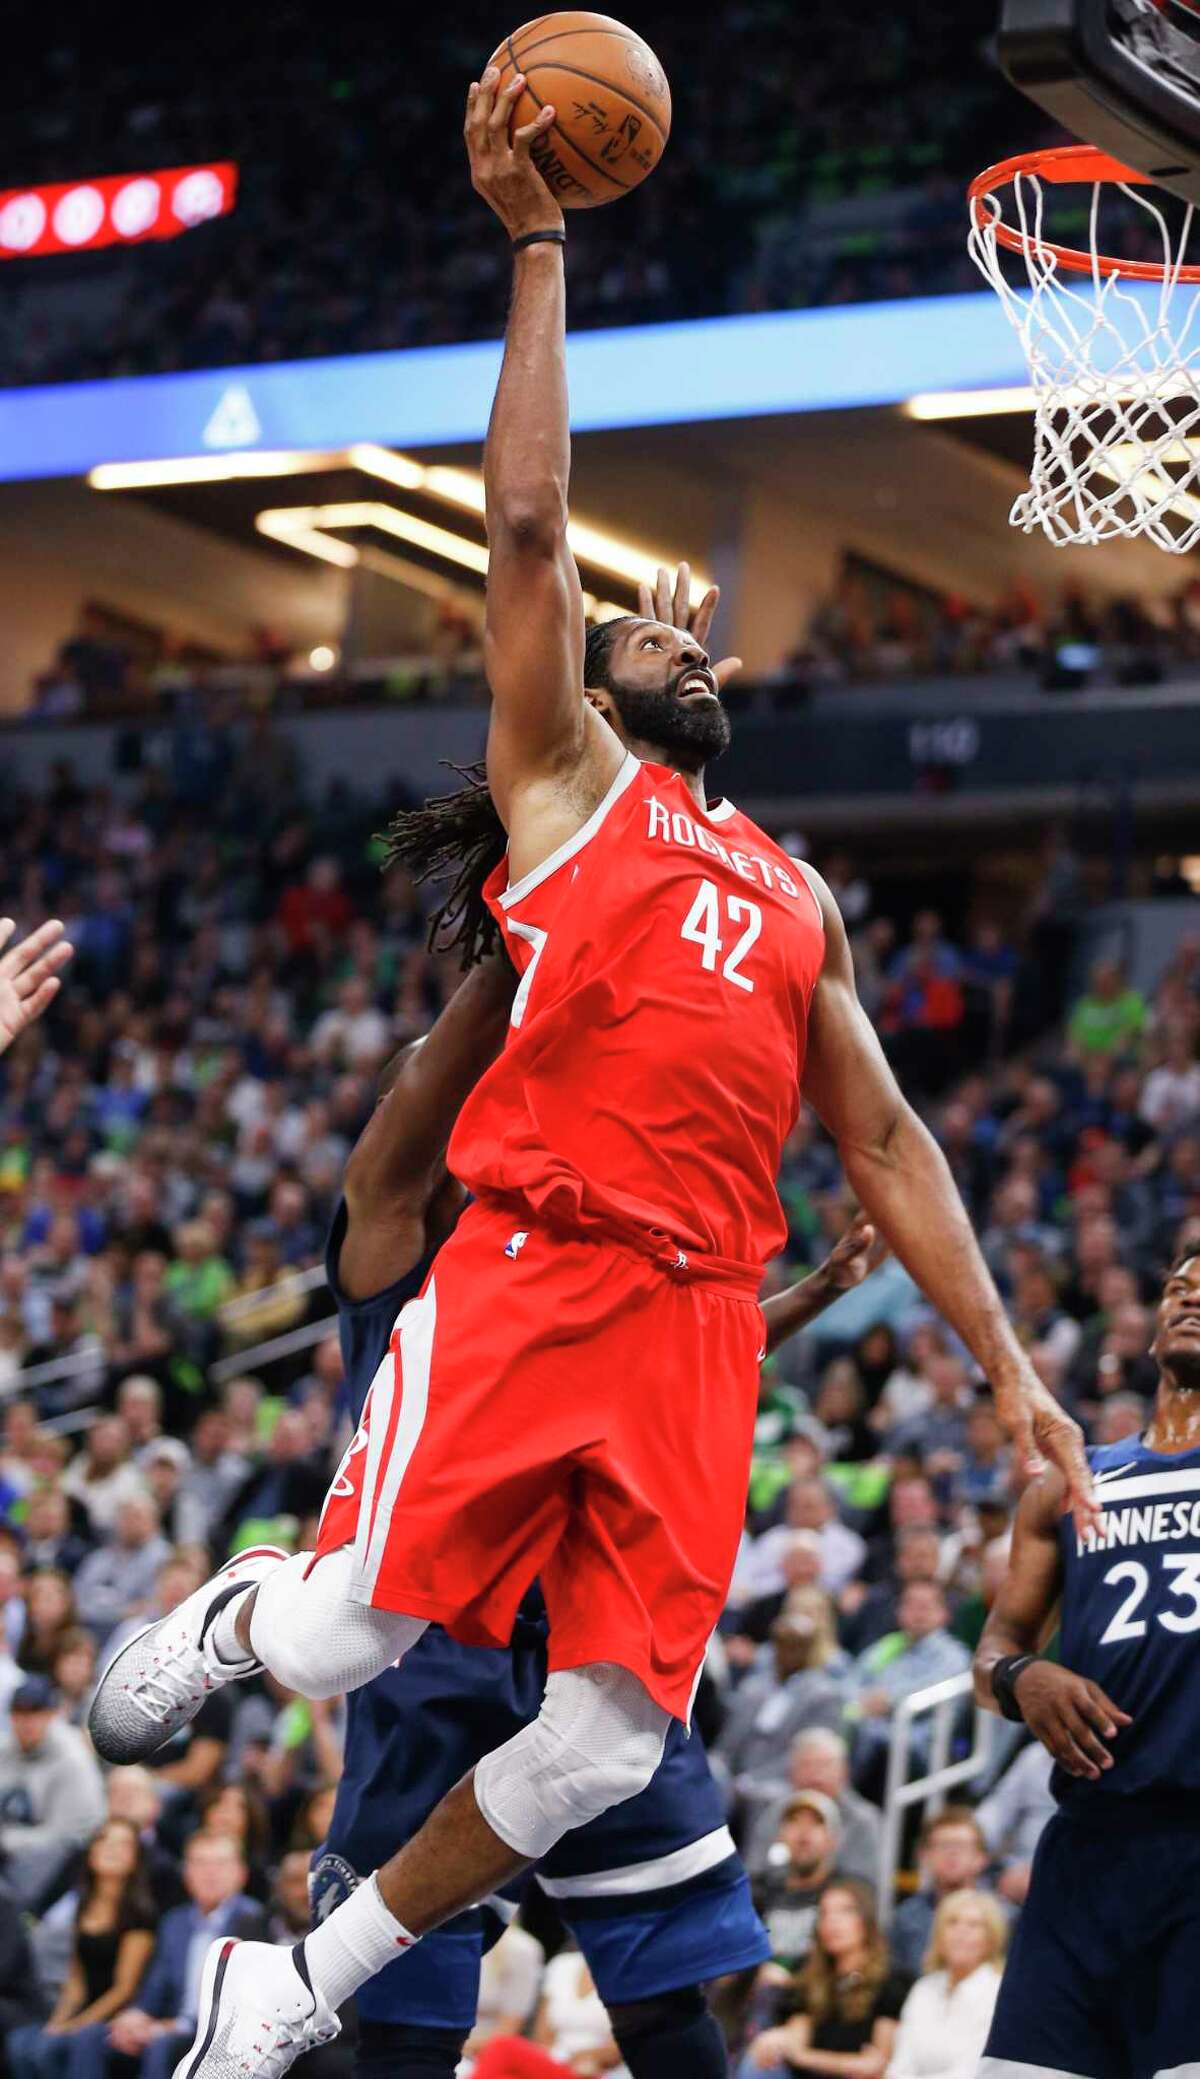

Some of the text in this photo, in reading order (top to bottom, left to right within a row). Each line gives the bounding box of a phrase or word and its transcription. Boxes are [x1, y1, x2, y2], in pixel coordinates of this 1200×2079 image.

[643, 795, 799, 899] ROCKETS
[680, 878, 762, 993] 42
[1099, 1553, 1200, 1645] 23
